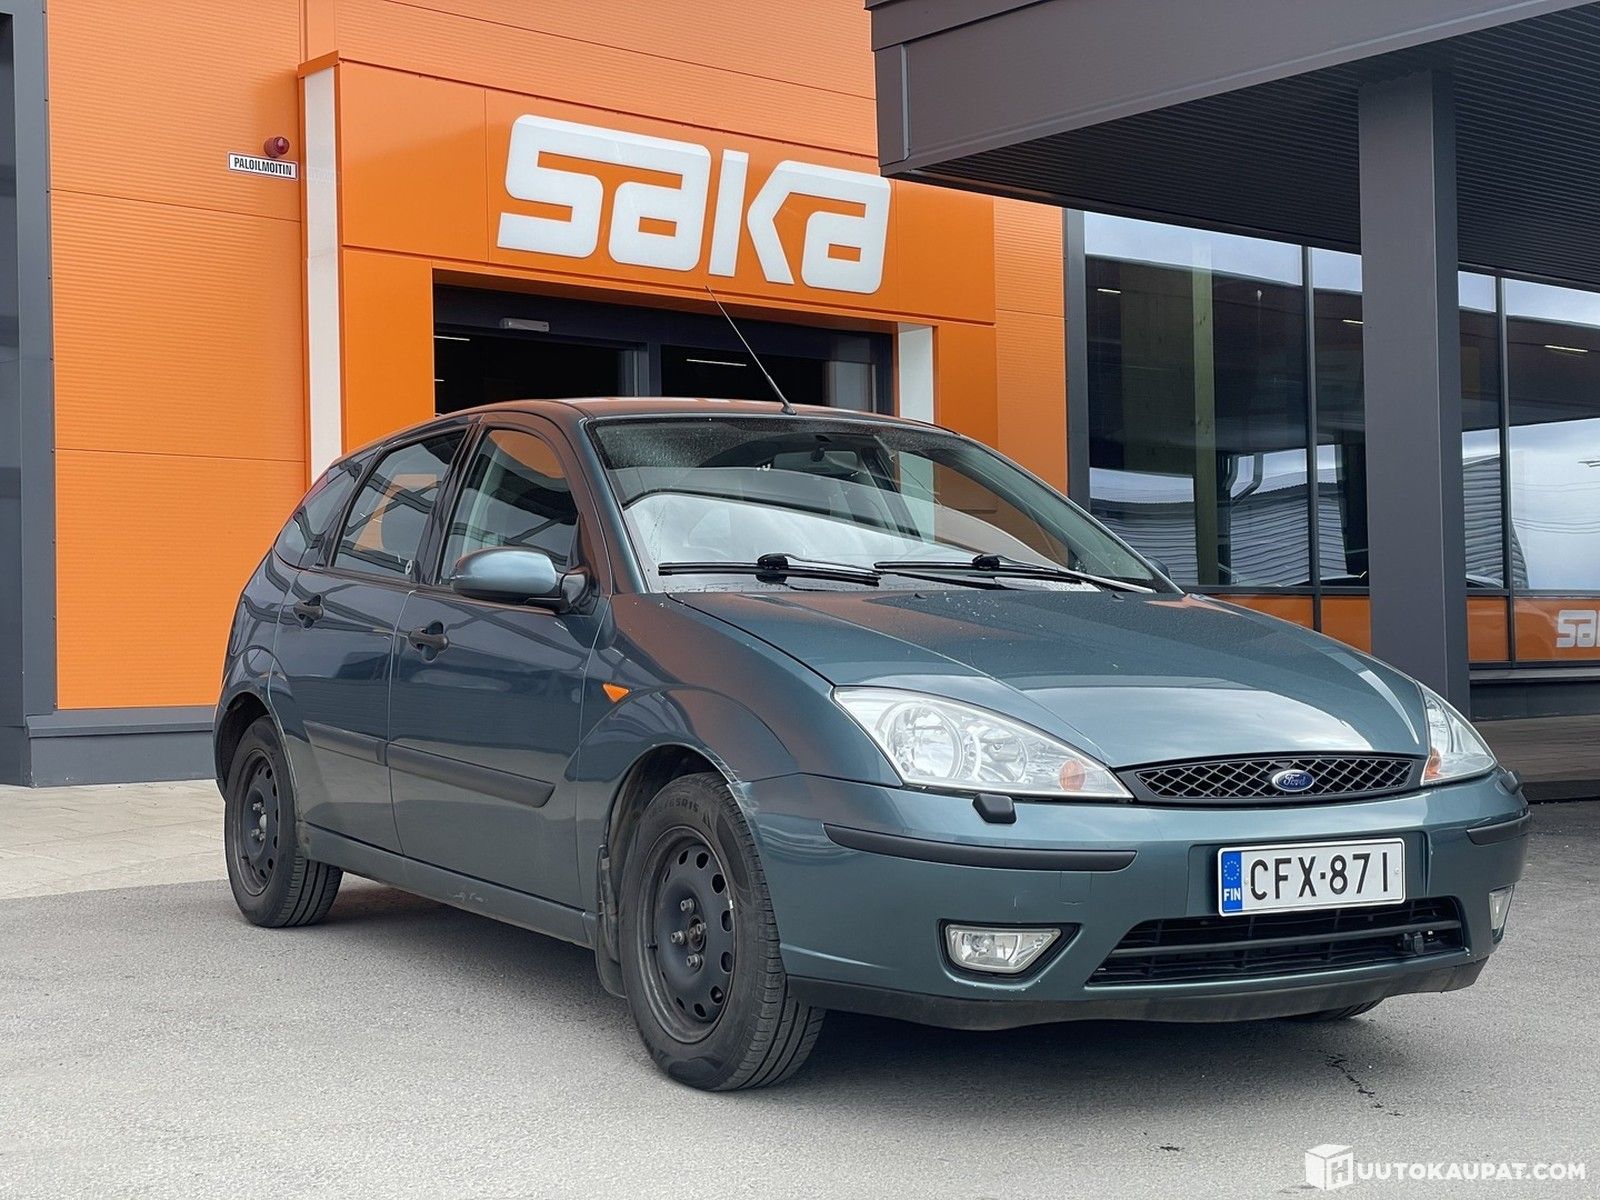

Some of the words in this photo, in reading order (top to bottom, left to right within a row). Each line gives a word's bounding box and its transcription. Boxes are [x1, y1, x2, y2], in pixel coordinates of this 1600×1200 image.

[233, 156, 292, 176] PALOILMOITIN
[1223, 888, 1241, 902] FIN
[1250, 852, 1388, 901] CFX-871
